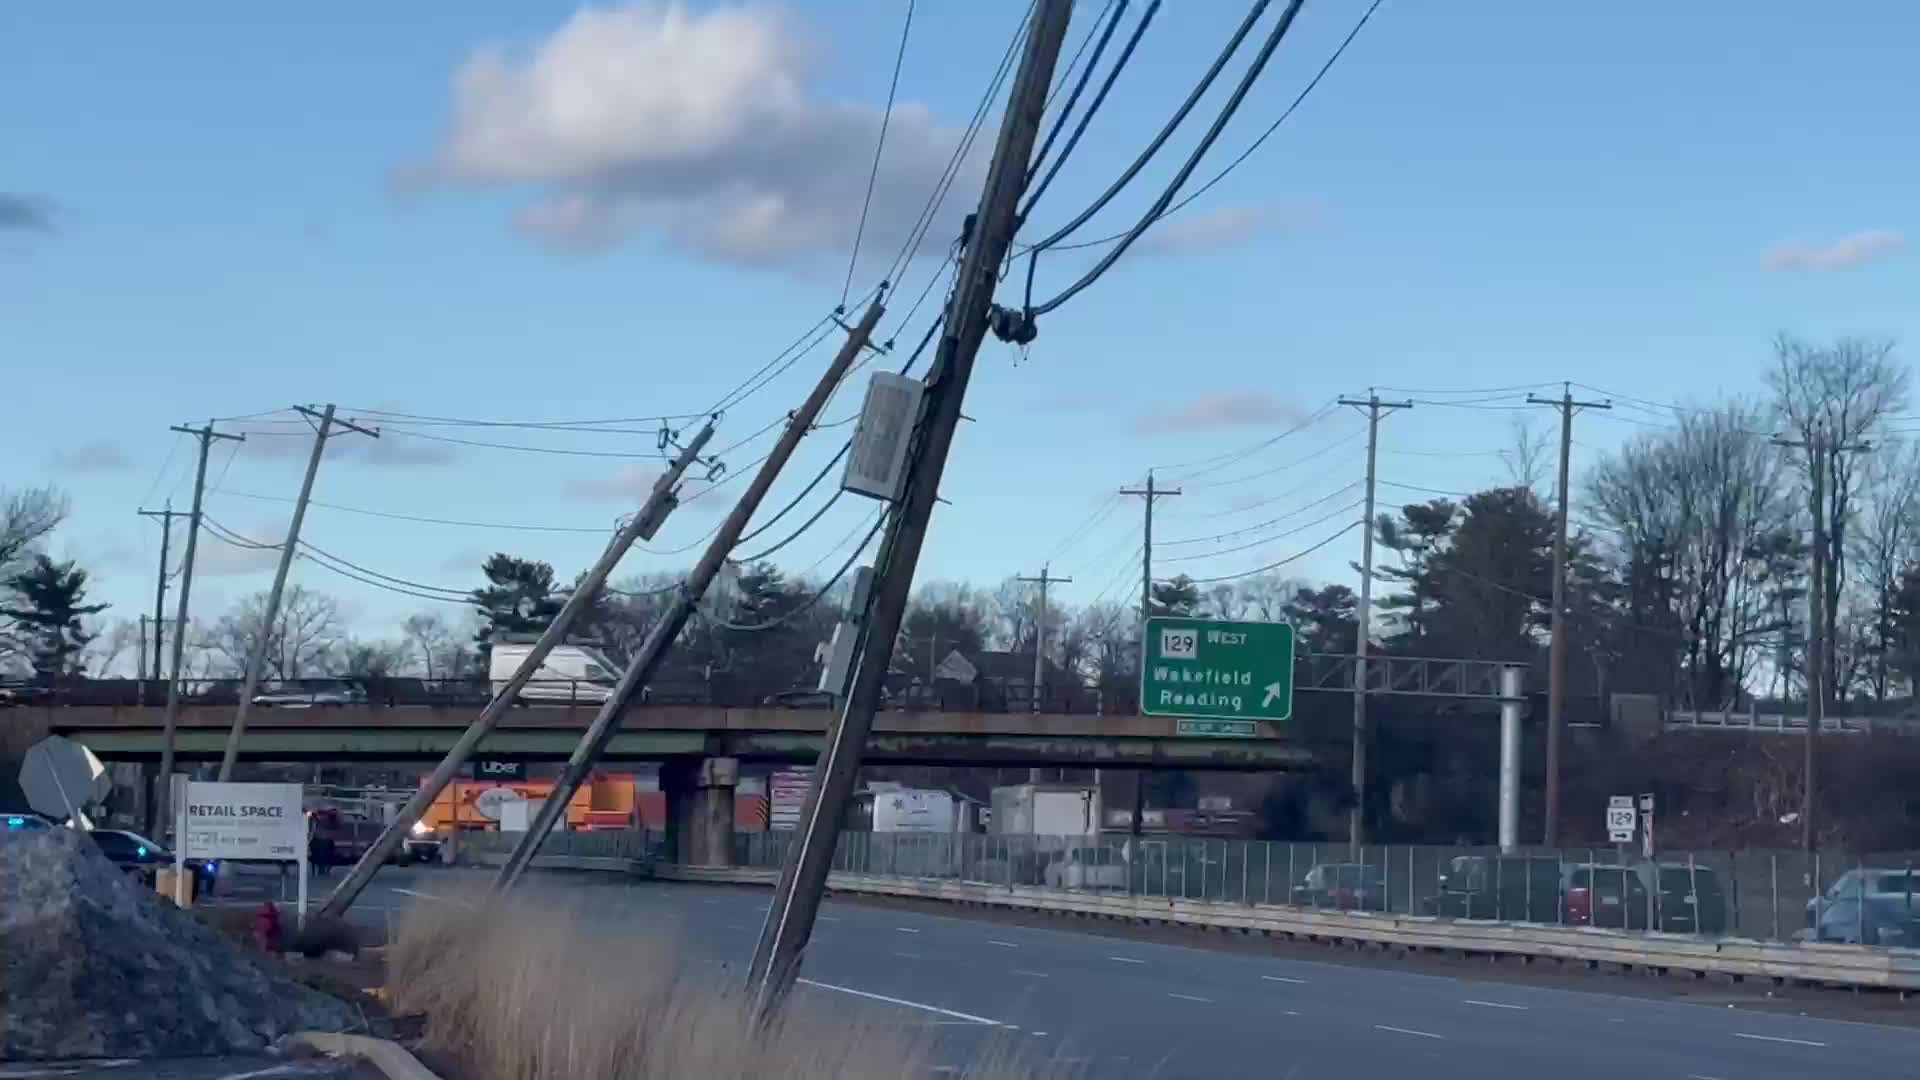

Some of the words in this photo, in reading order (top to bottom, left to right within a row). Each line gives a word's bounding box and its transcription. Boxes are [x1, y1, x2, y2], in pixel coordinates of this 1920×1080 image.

[1164, 635, 1194, 652] 129
[1207, 630, 1247, 645] WEST
[1153, 666, 1252, 686] Wakefield
[1159, 689, 1242, 712] Reading
[188, 804, 237, 817] RETAIL
[239, 805, 283, 818] SPACE
[1610, 811, 1633, 825] 129
